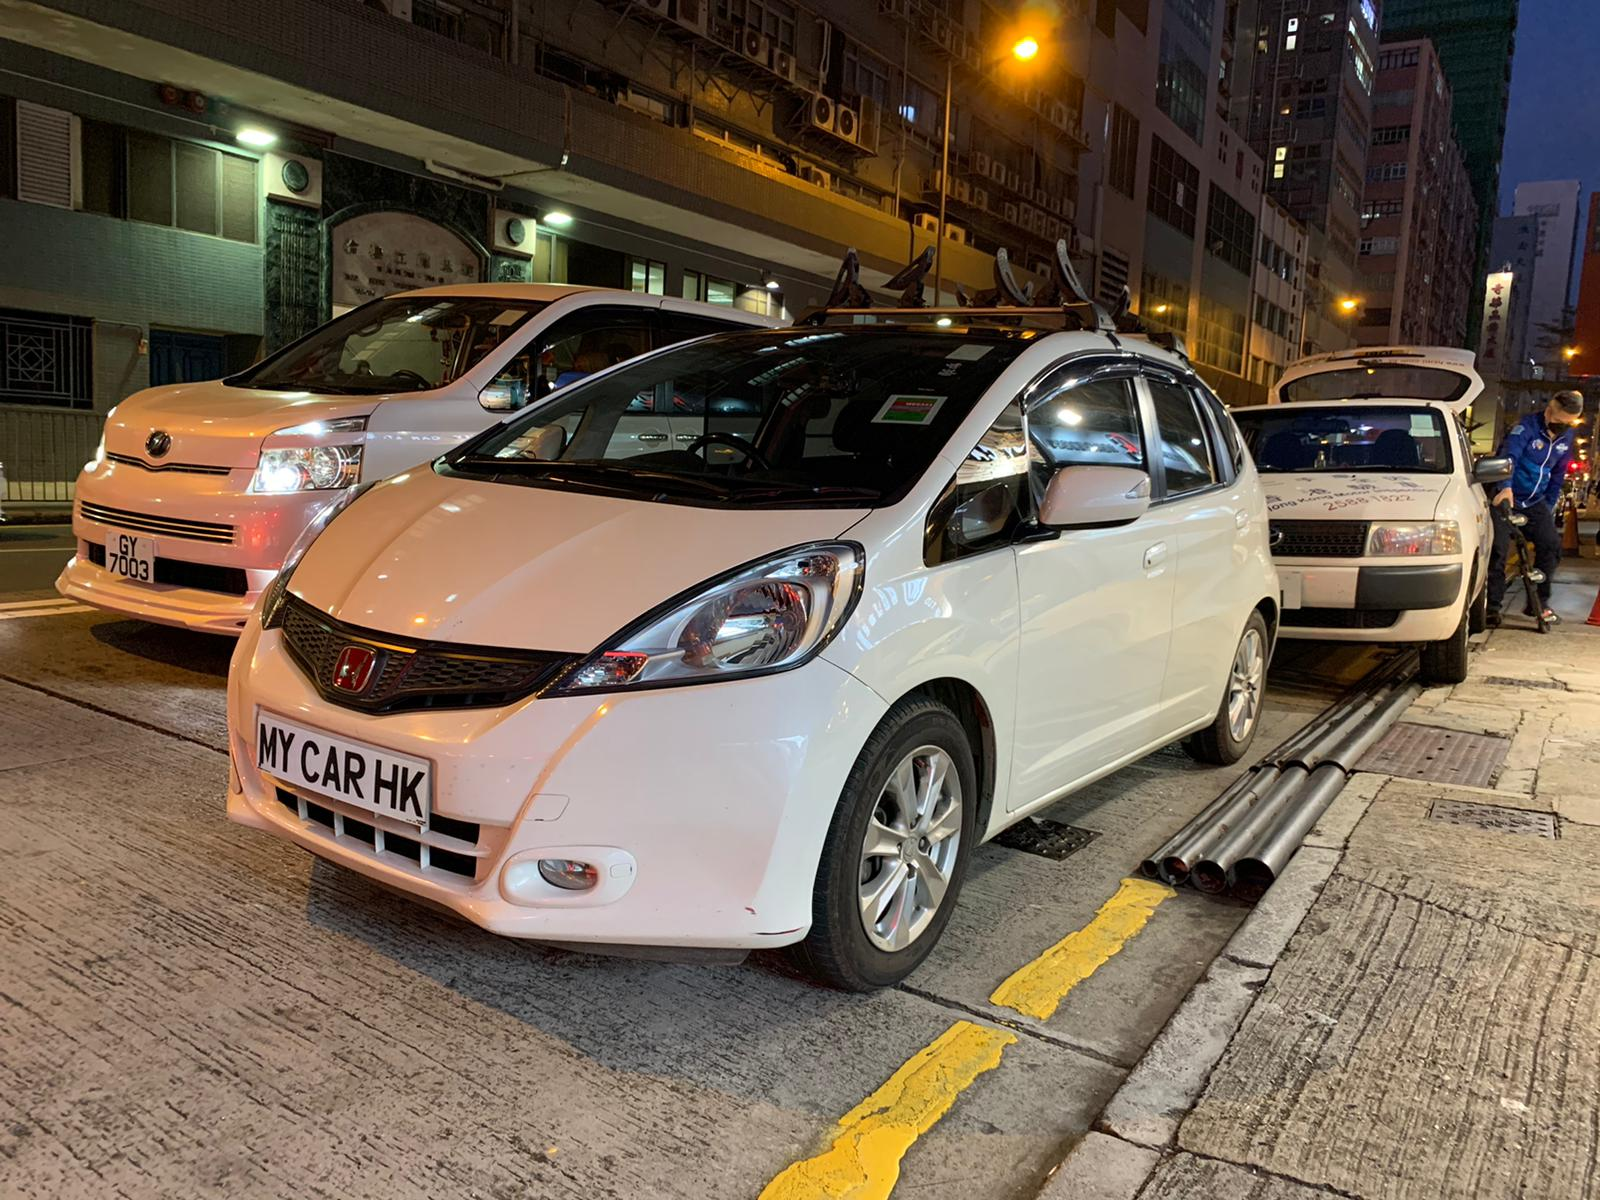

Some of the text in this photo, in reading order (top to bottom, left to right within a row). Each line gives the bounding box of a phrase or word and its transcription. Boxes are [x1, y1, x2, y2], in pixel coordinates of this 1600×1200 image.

[119, 534, 138, 557] GY
[109, 552, 149, 581] 7003
[259, 723, 425, 818] MY CAR HK
